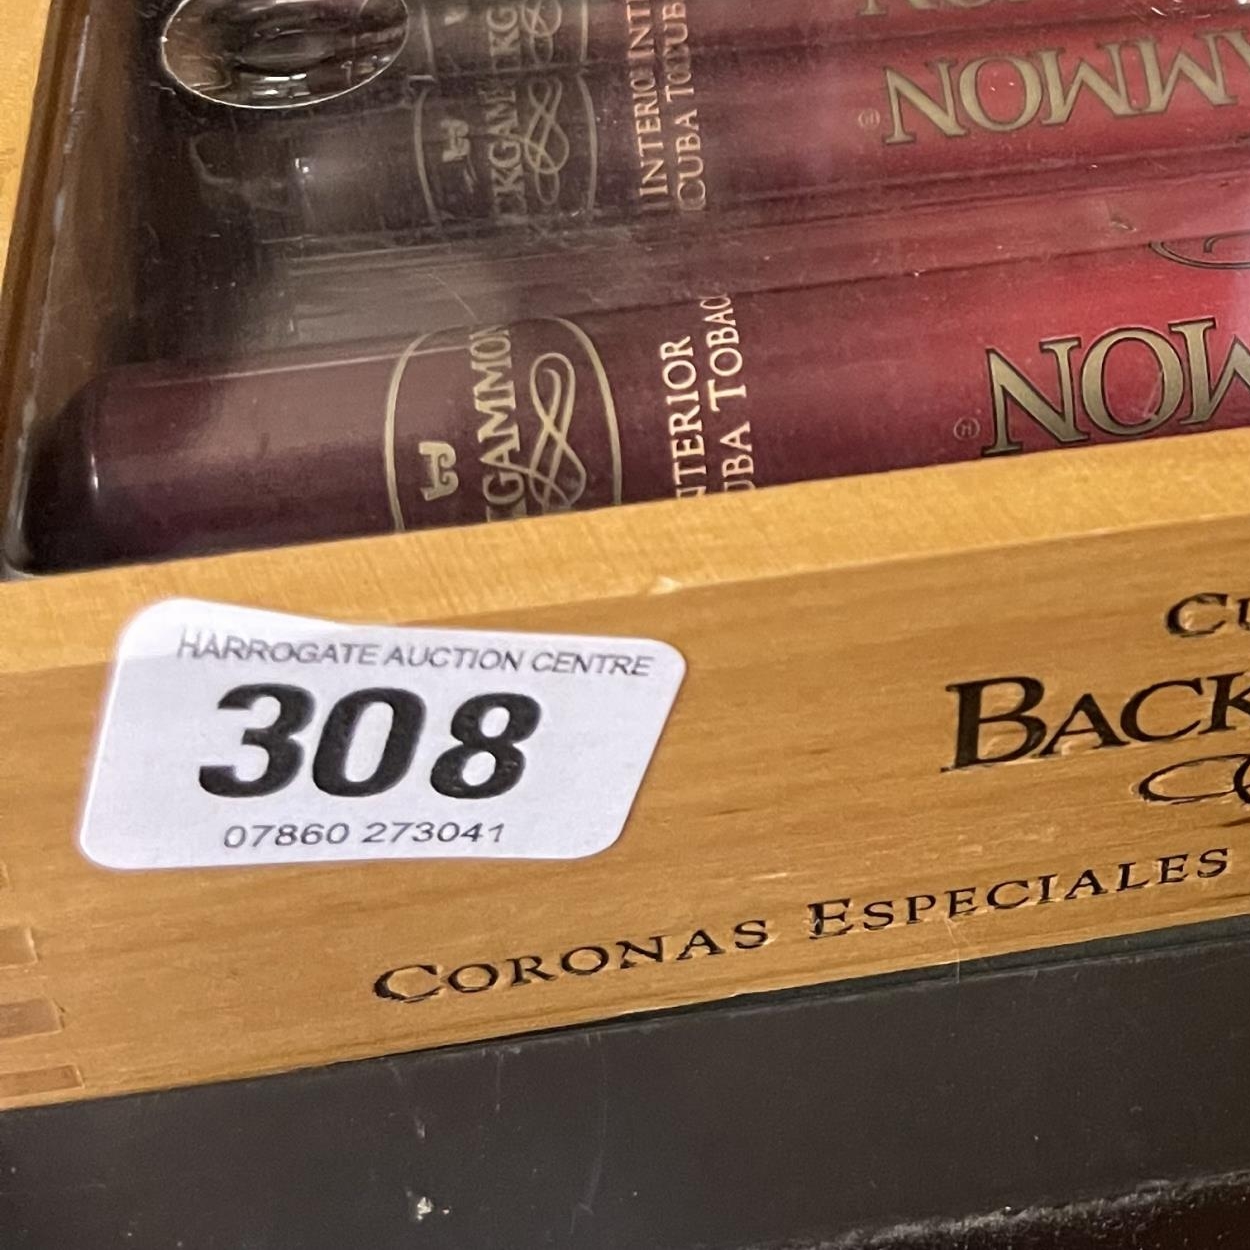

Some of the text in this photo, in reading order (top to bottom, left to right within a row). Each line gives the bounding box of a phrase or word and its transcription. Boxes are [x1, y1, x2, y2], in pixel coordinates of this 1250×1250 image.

[177, 626, 655, 678] HARROGATE AUCTION CENTRE
[198, 683, 544, 801] 308
[222, 820, 506, 850] 07860 273041
[372, 916, 771, 1004] CORONAS
[808, 845, 1231, 940] ESPECIALES
